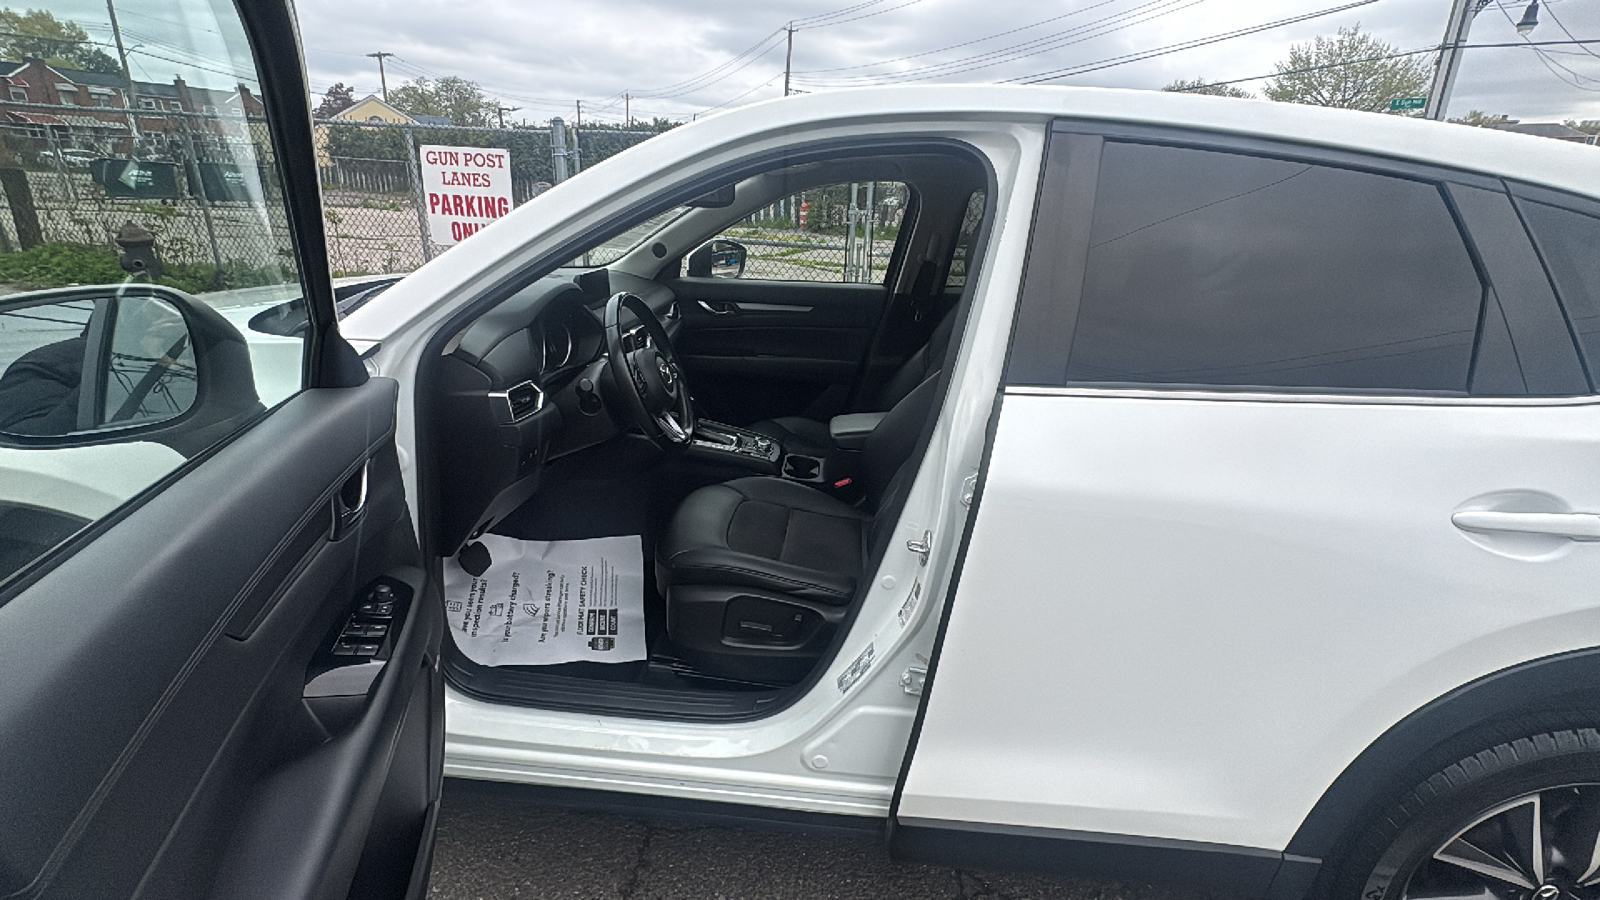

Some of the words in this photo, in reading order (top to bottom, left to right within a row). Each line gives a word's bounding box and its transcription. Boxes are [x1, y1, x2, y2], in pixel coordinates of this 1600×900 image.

[426, 150, 459, 166] GUN
[463, 153, 504, 168] POST
[441, 171, 491, 187] LANES
[428, 193, 509, 219] PARKING
[451, 221, 489, 242] ON
[470, 577, 478, 592] your
[509, 572, 520, 600] charged?
[545, 570, 555, 602] streaking?
[467, 593, 475, 607] seen
[578, 586, 587, 607] SAFETY
[464, 608, 472, 621] you
[471, 605, 483, 637] inspection
[478, 579, 487, 603] results?
[504, 601, 517, 625] battery
[542, 603, 551, 622] wipers
[461, 621, 469, 633] ave
[504, 626, 512, 637] your
[538, 633, 546, 643] Are
